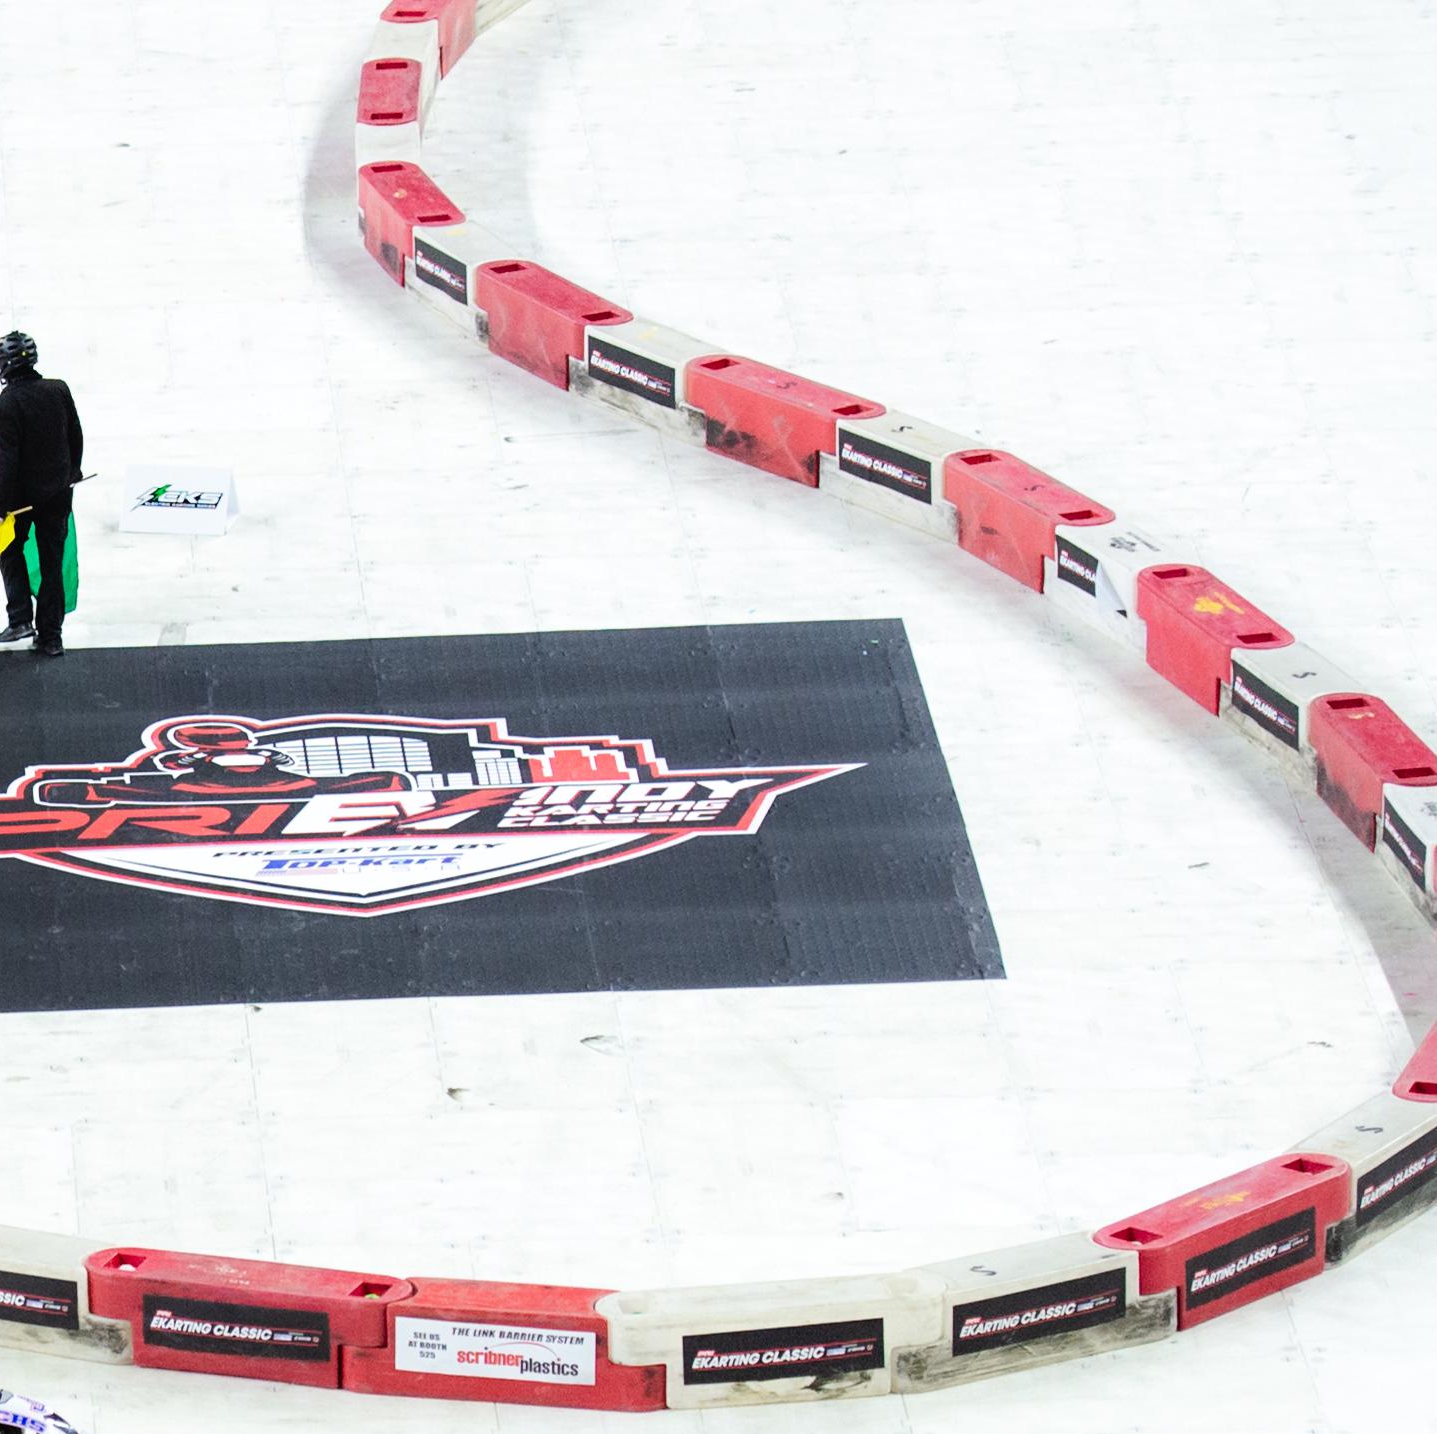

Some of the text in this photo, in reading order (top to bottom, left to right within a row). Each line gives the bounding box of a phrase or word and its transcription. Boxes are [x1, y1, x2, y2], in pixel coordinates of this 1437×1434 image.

[497, 809, 722, 828] CLASSIC
[503, 799, 730, 818] KARTING
[212, 842, 506, 858] PRESENTED BY
[1394, 1157, 1427, 1189] CLASSIC
[1190, 1245, 1278, 1293] EKARTING CLASSIC
[149, 1316, 213, 1335] EKARTING
[213, 1324, 273, 1341] CLASSIC
[959, 1314, 1020, 1339] EKARTING
[1020, 1302, 1077, 1325] CLASSIC
[451, 1327, 585, 1345] THE LINK BARRIER SYSTEM
[691, 1352, 761, 1369] EKARTING
[762, 1346, 826, 1364] CLASSIC
